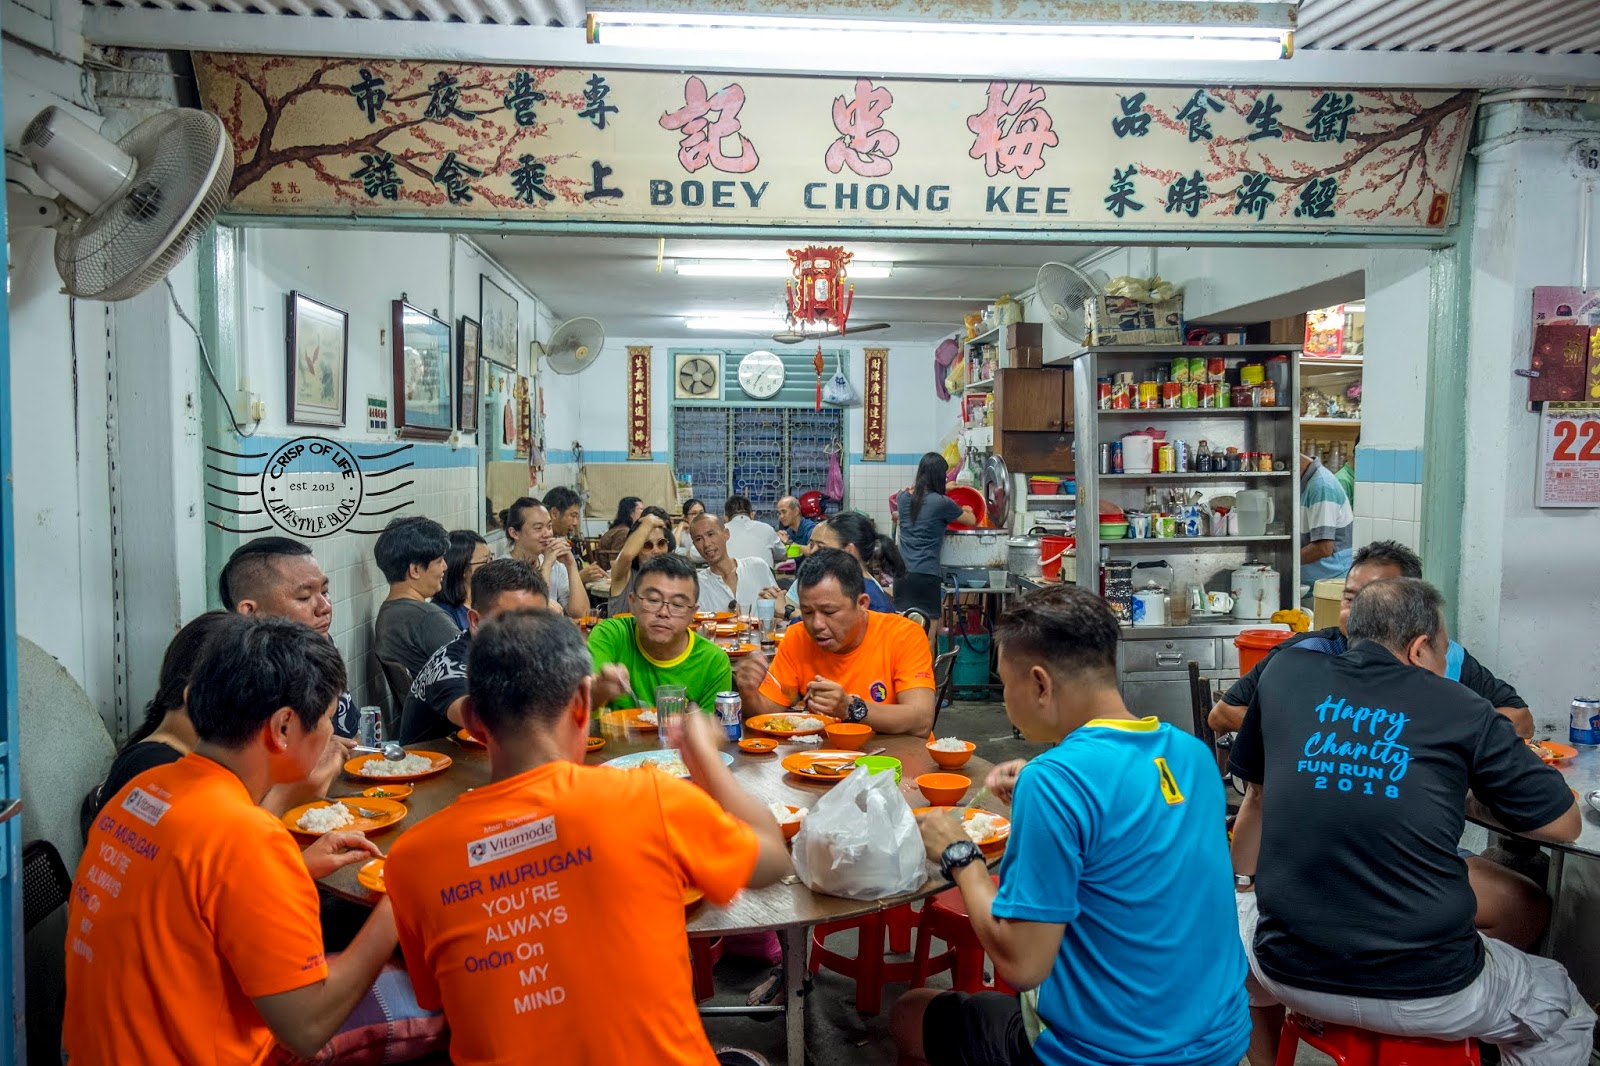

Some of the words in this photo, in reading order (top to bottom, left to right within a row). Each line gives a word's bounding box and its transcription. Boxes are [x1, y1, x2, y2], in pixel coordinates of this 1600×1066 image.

[649, 179, 770, 209] BOEY
[803, 182, 951, 212] CHONG
[985, 185, 1072, 215] KEE
[1429, 195, 1446, 223] 6
[1552, 420, 1600, 461] 22
[1314, 694, 1412, 742] Happy
[1297, 760, 1335, 774] FUN
[1338, 762, 1384, 780] RUN
[1304, 731, 1415, 782] Charity
[1314, 776, 1400, 799] 2018
[113, 825, 161, 862] MURUGAN
[489, 821, 553, 852] Vitamode
[87, 864, 123, 898] ALWAYS
[440, 879, 485, 906] MGR
[489, 846, 593, 893] MURUGAN
[481, 881, 561, 918] YOU'RE
[485, 905, 568, 944] ALWAYS
[464, 950, 514, 974] OnOn
[516, 942, 544, 961] On
[519, 963, 550, 987] MY
[513, 986, 566, 1015] MIND
